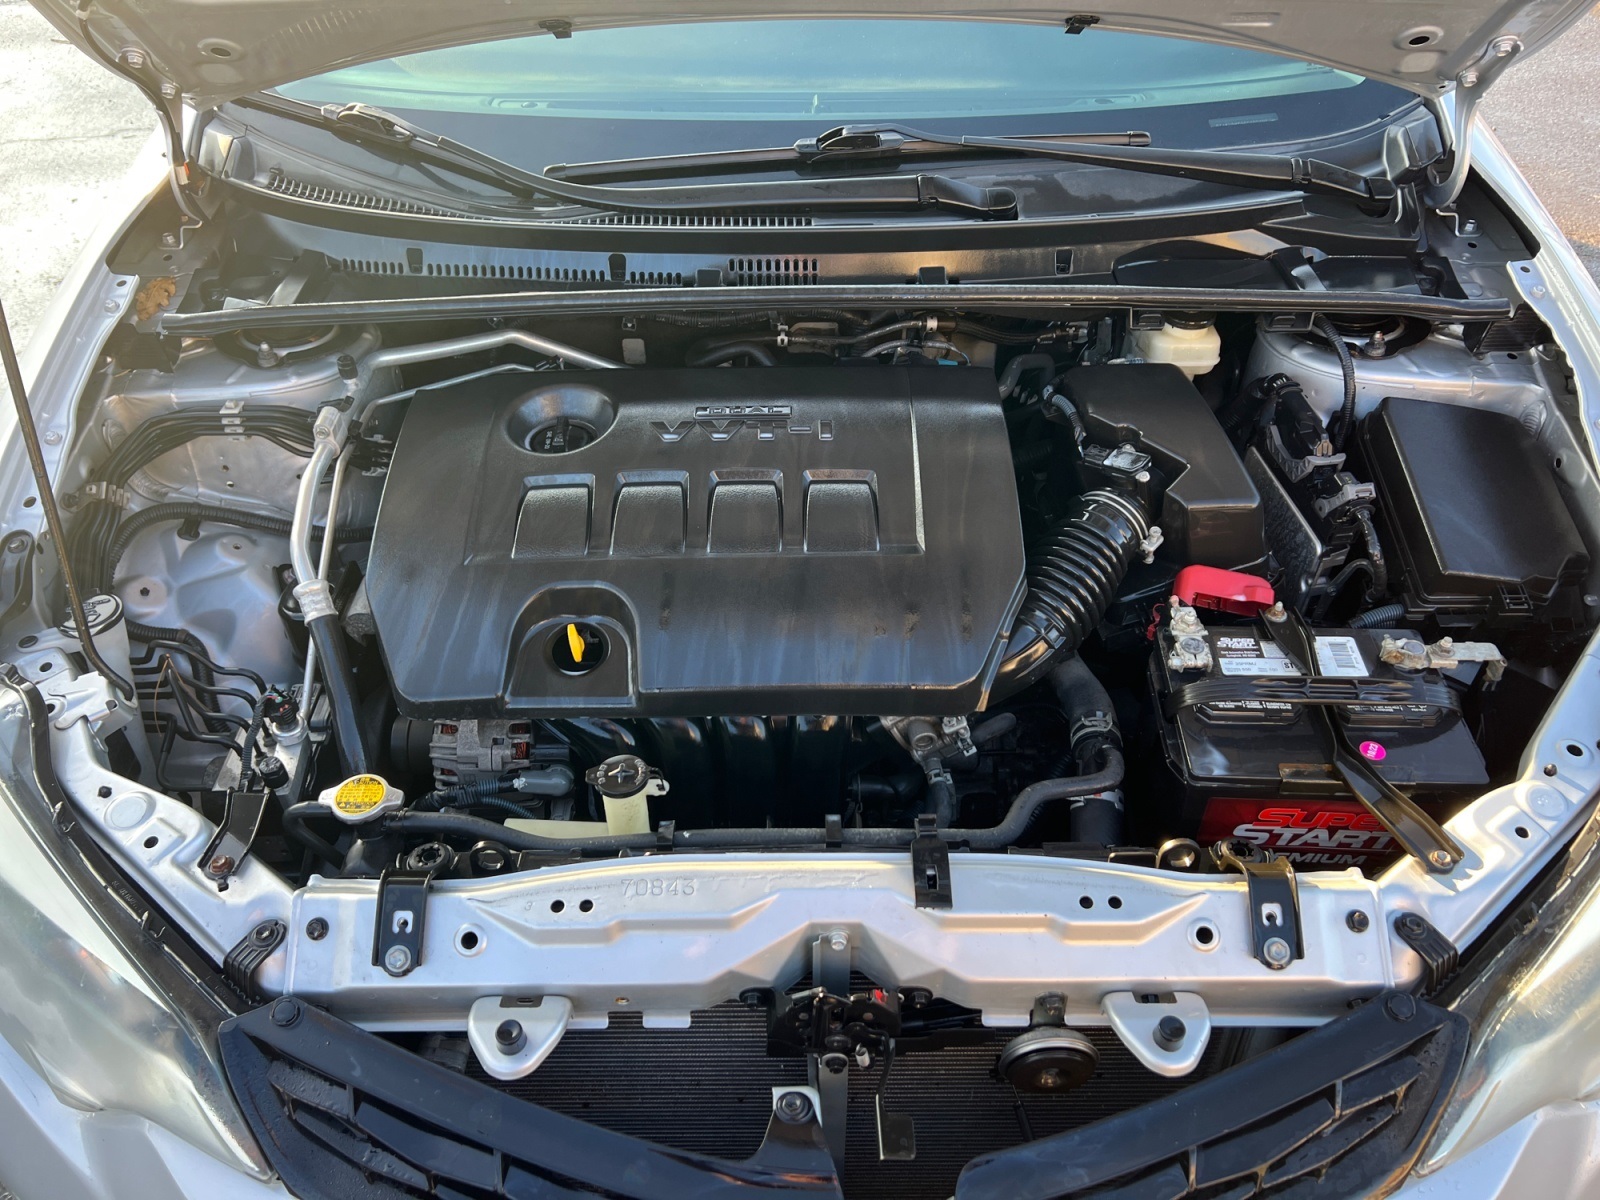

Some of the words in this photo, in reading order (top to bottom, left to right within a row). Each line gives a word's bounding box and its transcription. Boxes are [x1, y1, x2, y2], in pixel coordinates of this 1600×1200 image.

[1252, 807, 1387, 831] SUPE
[1233, 823, 1393, 849] START
[621, 878, 697, 897] 70843
